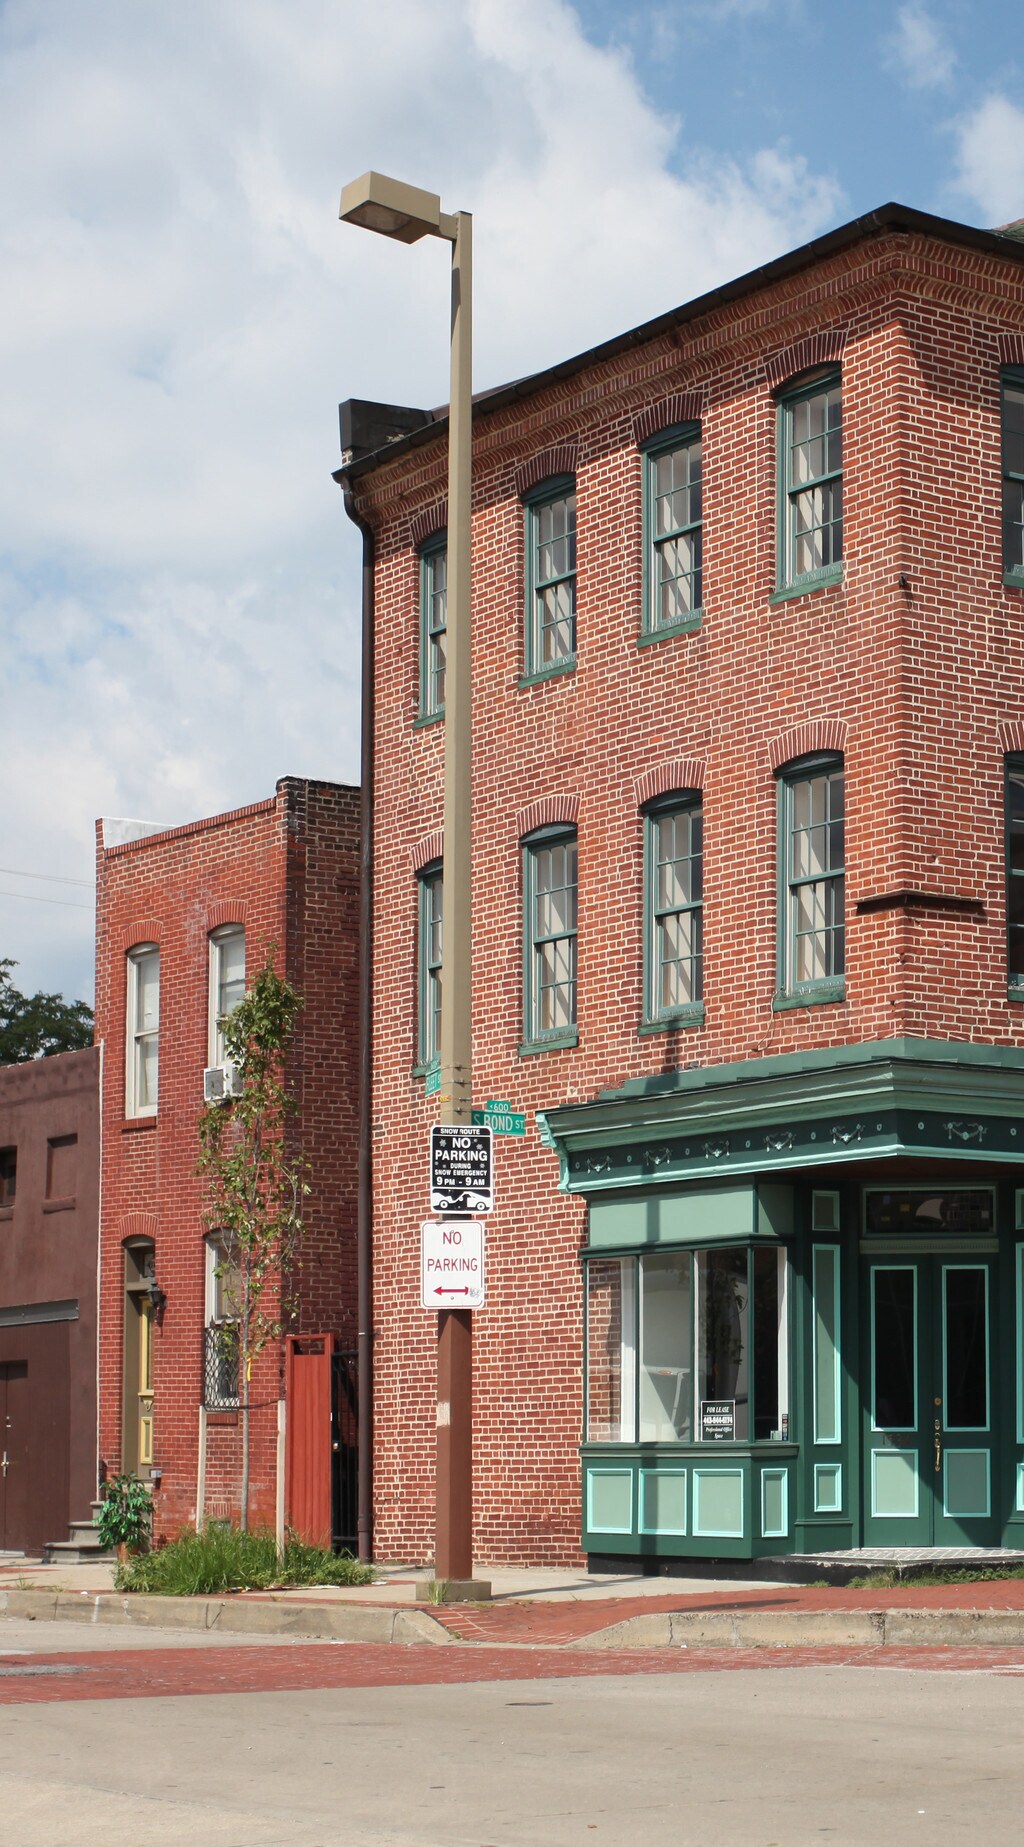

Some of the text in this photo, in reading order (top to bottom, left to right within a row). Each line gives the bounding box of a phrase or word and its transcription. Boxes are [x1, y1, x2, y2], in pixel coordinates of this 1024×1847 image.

[473, 1113, 524, 1131] S BOND ST
[452, 1137, 471, 1149] NO
[435, 1150, 488, 1161] PARKING
[443, 1231, 462, 1245] NO
[427, 1258, 478, 1272] PARKING
